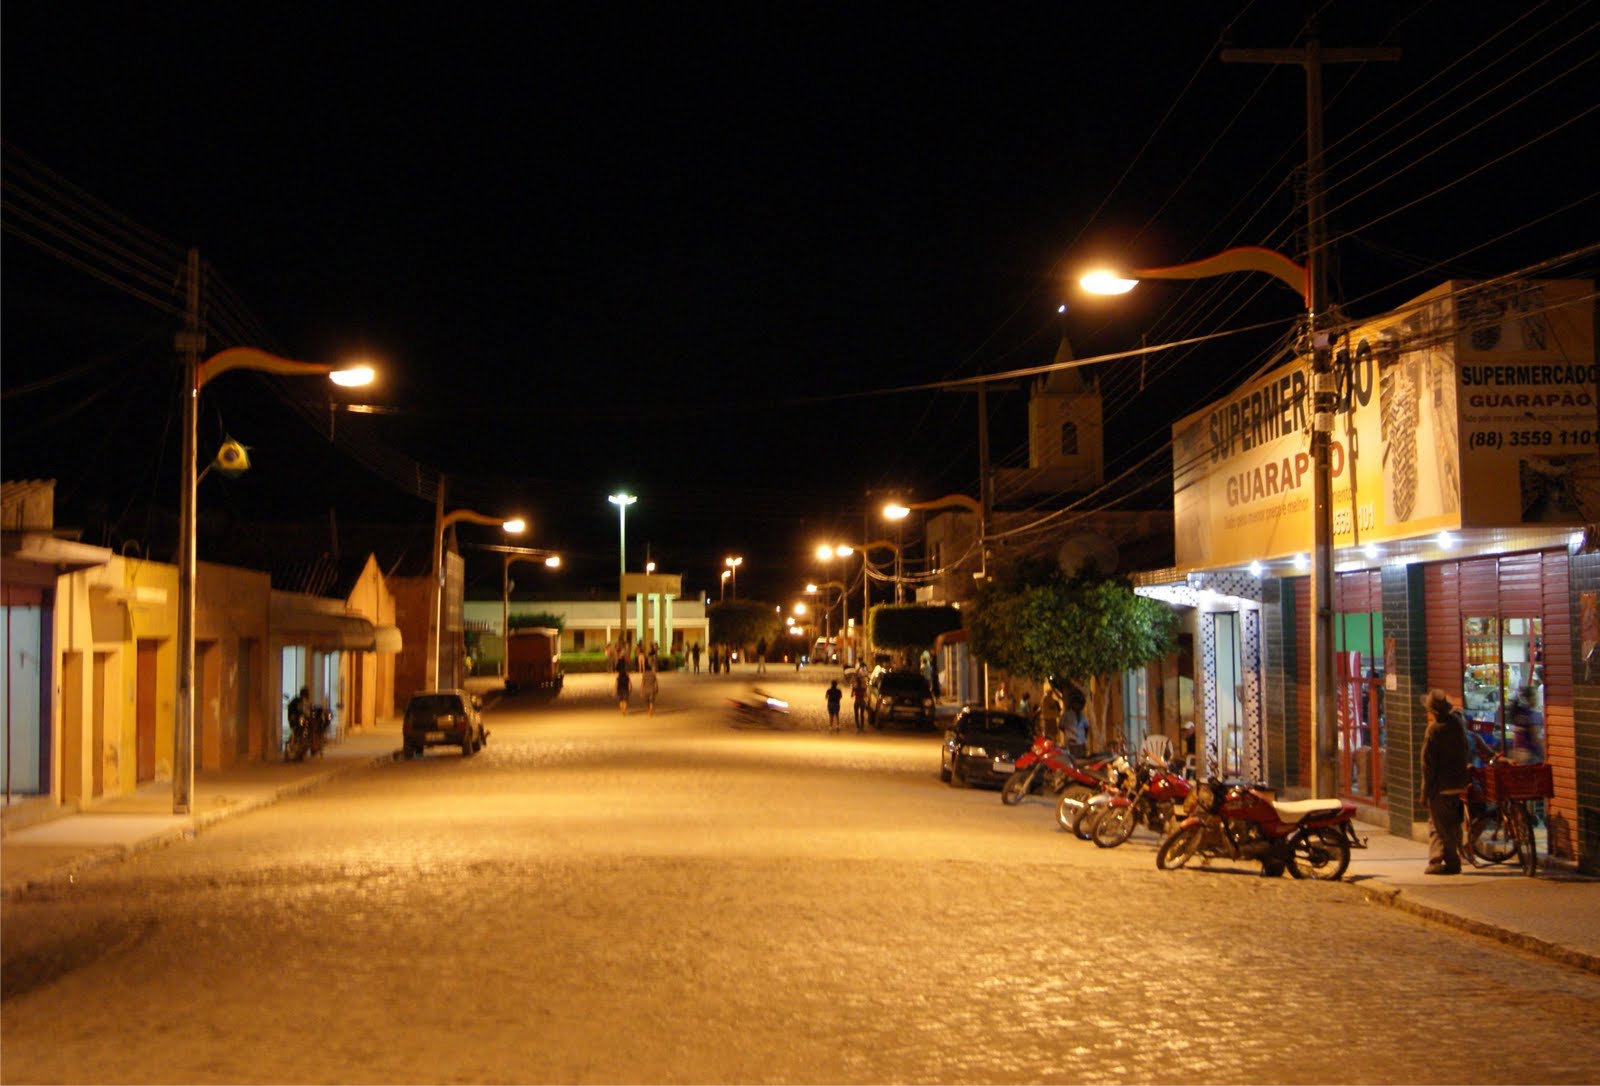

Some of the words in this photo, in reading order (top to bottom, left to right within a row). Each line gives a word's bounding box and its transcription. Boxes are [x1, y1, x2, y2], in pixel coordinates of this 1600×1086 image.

[1461, 365, 1600, 386] SUPERMERCADO
[1209, 338, 1373, 465] SUPERMERDO
[1469, 431, 1503, 450] (88)
[1510, 431, 1553, 447] 3559
[1559, 429, 1600, 446] 1101
[1226, 440, 1345, 507] GUARAPO
